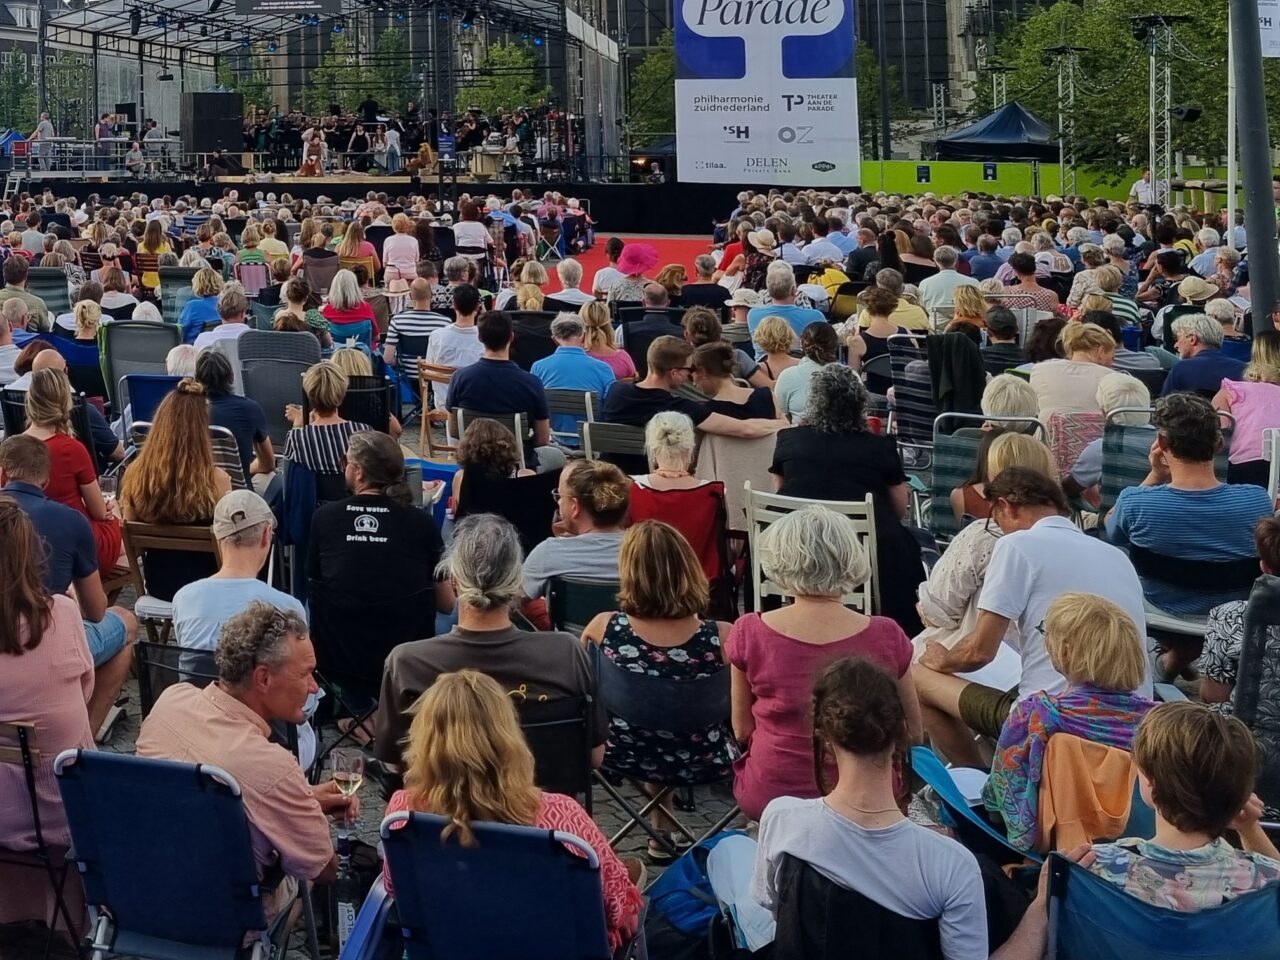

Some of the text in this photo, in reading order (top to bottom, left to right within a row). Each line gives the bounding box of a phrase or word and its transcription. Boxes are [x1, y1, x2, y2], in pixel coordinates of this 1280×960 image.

[694, 94, 764, 104] philharmonie
[694, 103, 770, 112] zuidnederland
[746, 157, 788, 167] DELEN
[346, 504, 364, 512] Save
[346, 534, 388, 543] Drink beer
